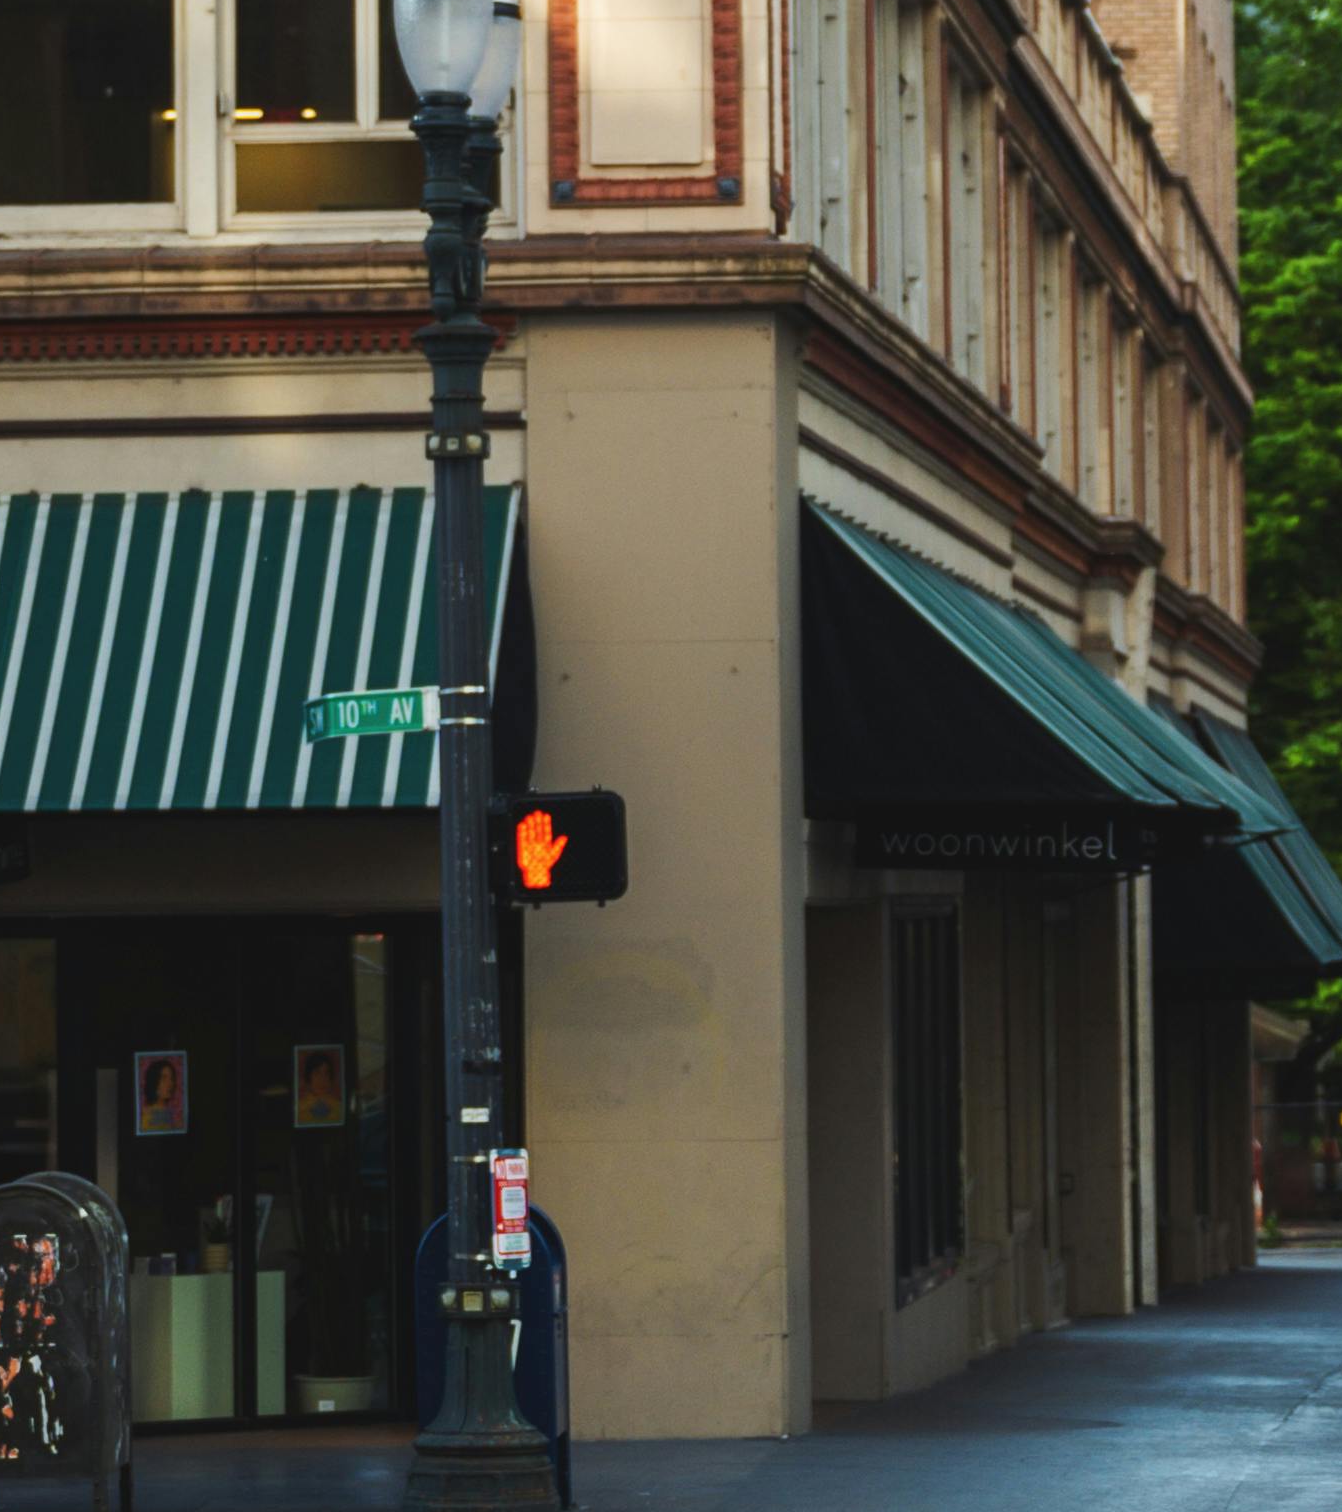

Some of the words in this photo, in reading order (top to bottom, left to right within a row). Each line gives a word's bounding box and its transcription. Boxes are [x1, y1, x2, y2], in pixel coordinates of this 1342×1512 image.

[337, 699, 377, 728] 10TH
[390, 697, 414, 725] AV
[880, 822, 1117, 860] woonwinkel
